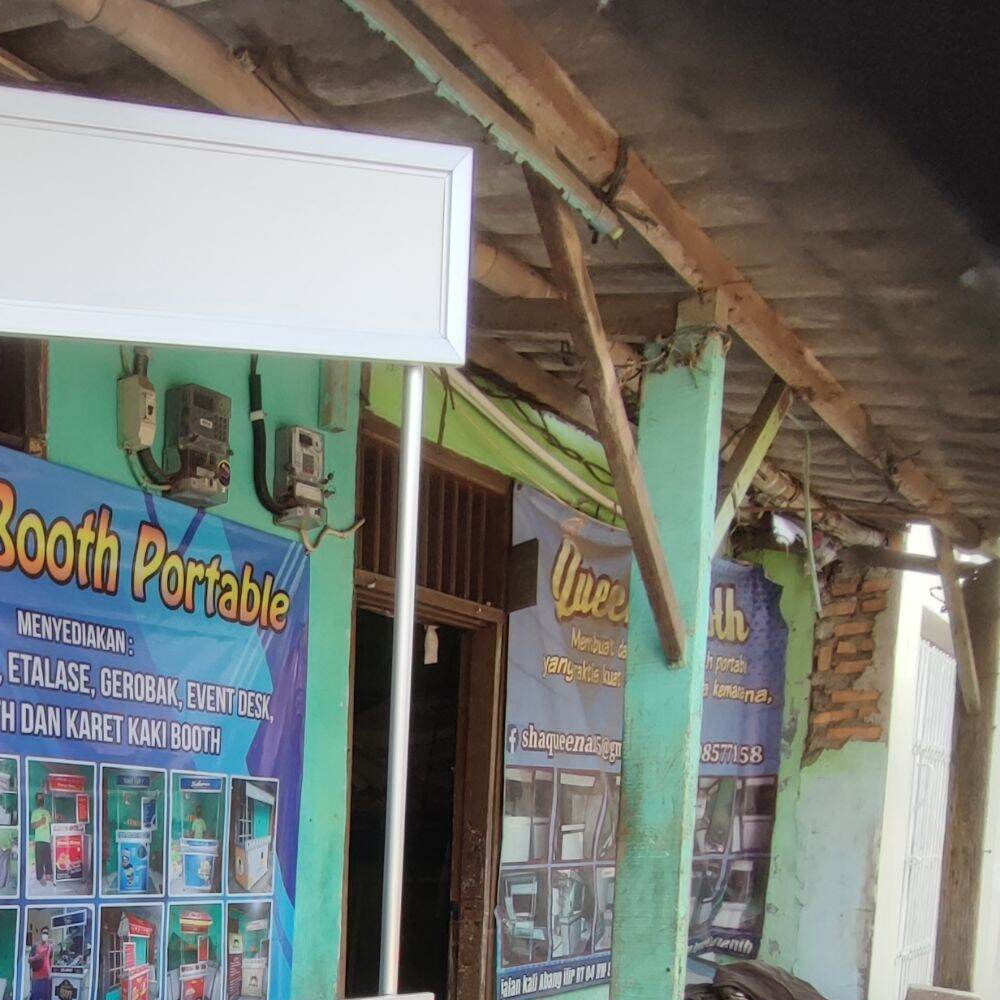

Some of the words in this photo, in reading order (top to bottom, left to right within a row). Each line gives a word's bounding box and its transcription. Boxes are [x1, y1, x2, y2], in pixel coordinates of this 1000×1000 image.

[131, 520, 290, 634] Portable
[553, 538, 628, 623] Quee
[17, 610, 126, 655] MENYEDIAKAN
[8, 652, 96, 697] ETALASE,
[101, 668, 183, 710] GEROBAK,
[187, 681, 235, 714] EVENT
[237, 689, 274, 723] DESK,
[21, 703, 61, 737] DAN
[66, 708, 124, 743] KARET
[128, 716, 167, 750] KAKI
[171, 722, 222, 755] BOOTH
